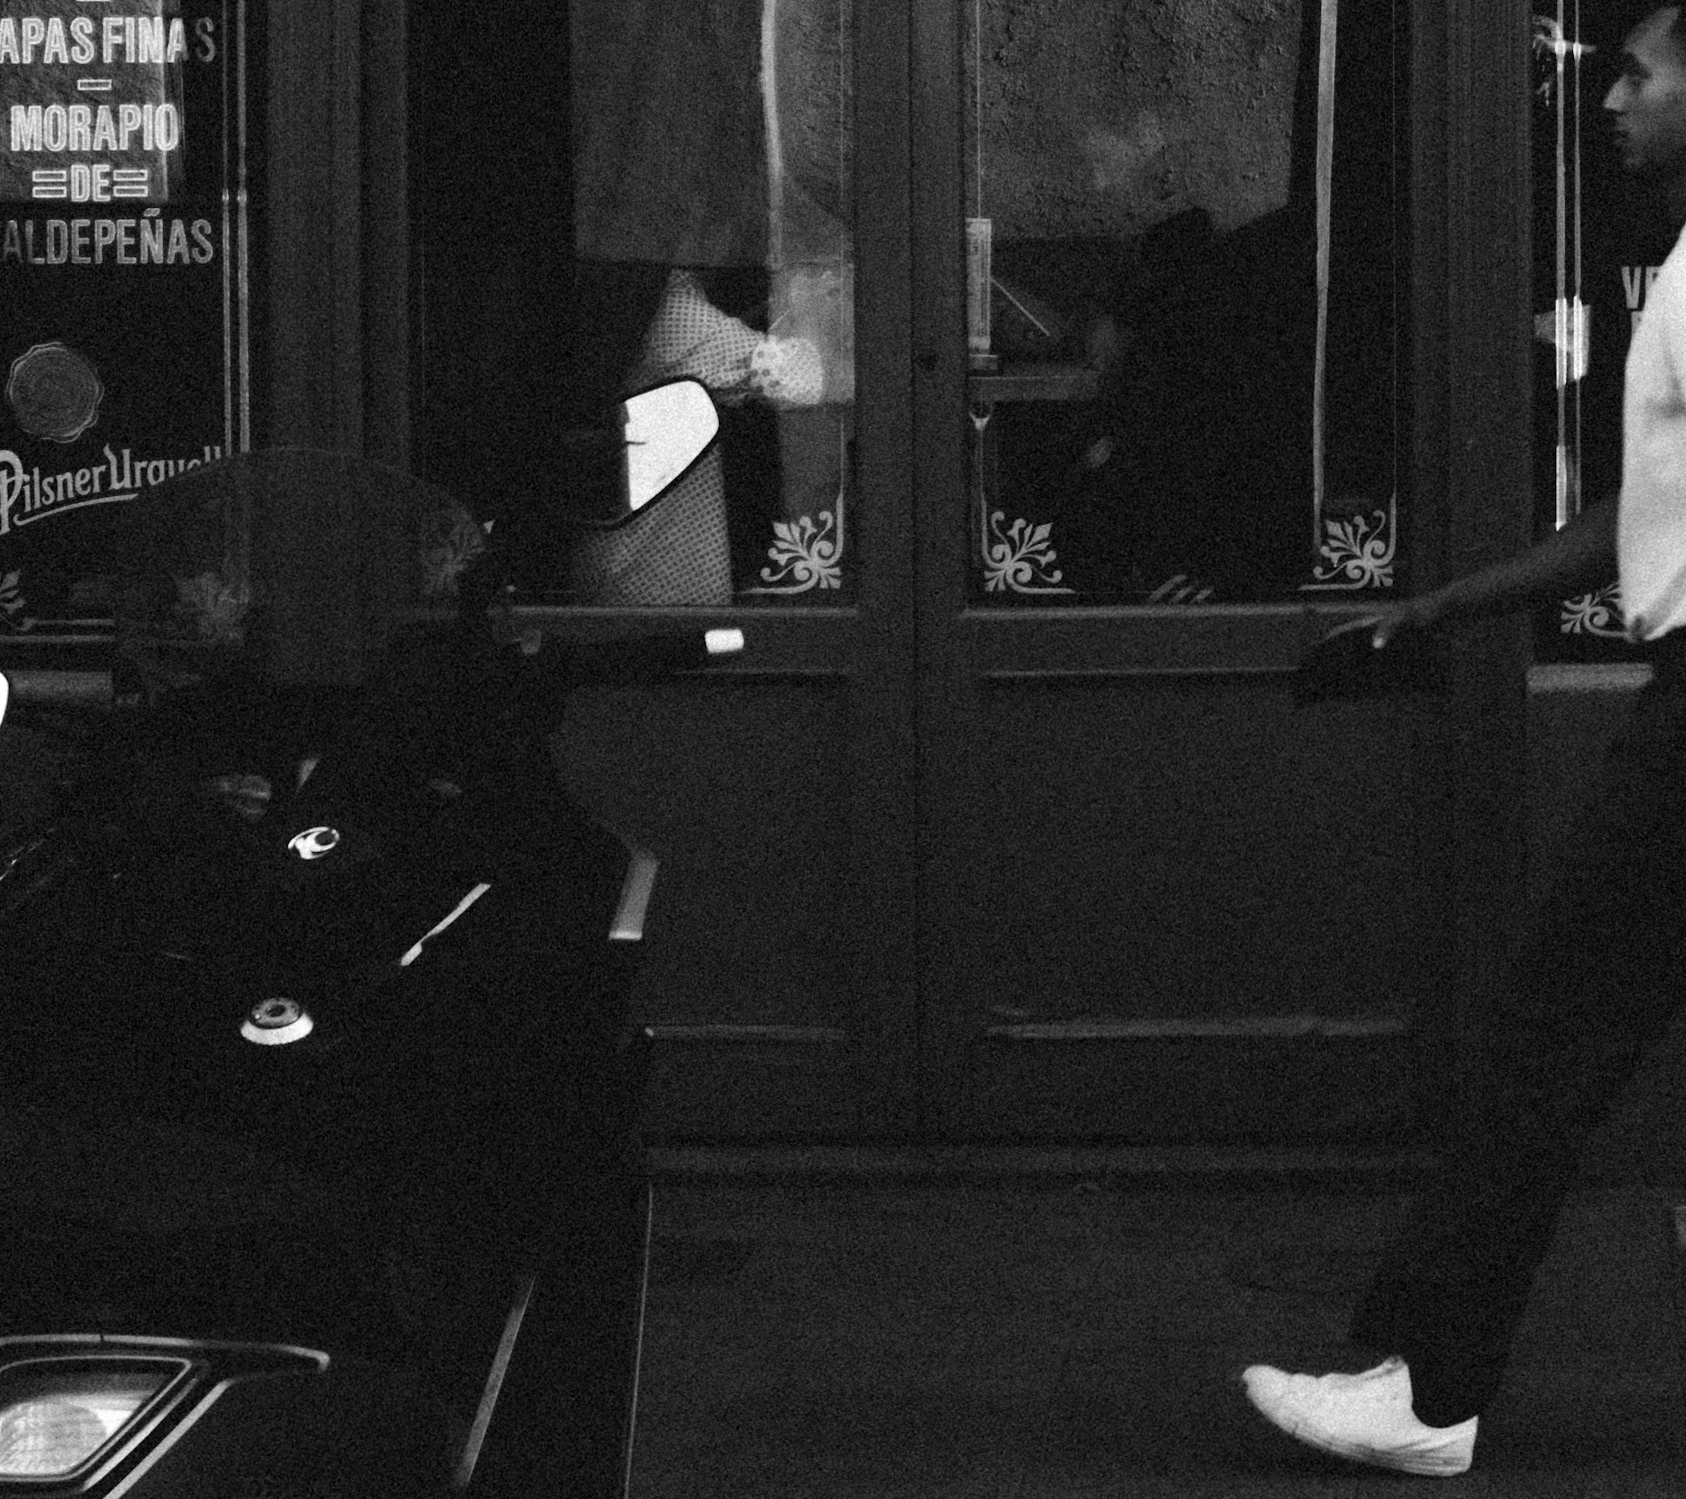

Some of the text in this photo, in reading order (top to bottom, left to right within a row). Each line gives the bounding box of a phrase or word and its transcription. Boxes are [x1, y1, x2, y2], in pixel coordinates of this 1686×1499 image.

[102, 15, 216, 65] FINAS
[10, 102, 180, 153] MORAPIO
[69, 163, 112, 203] DE
